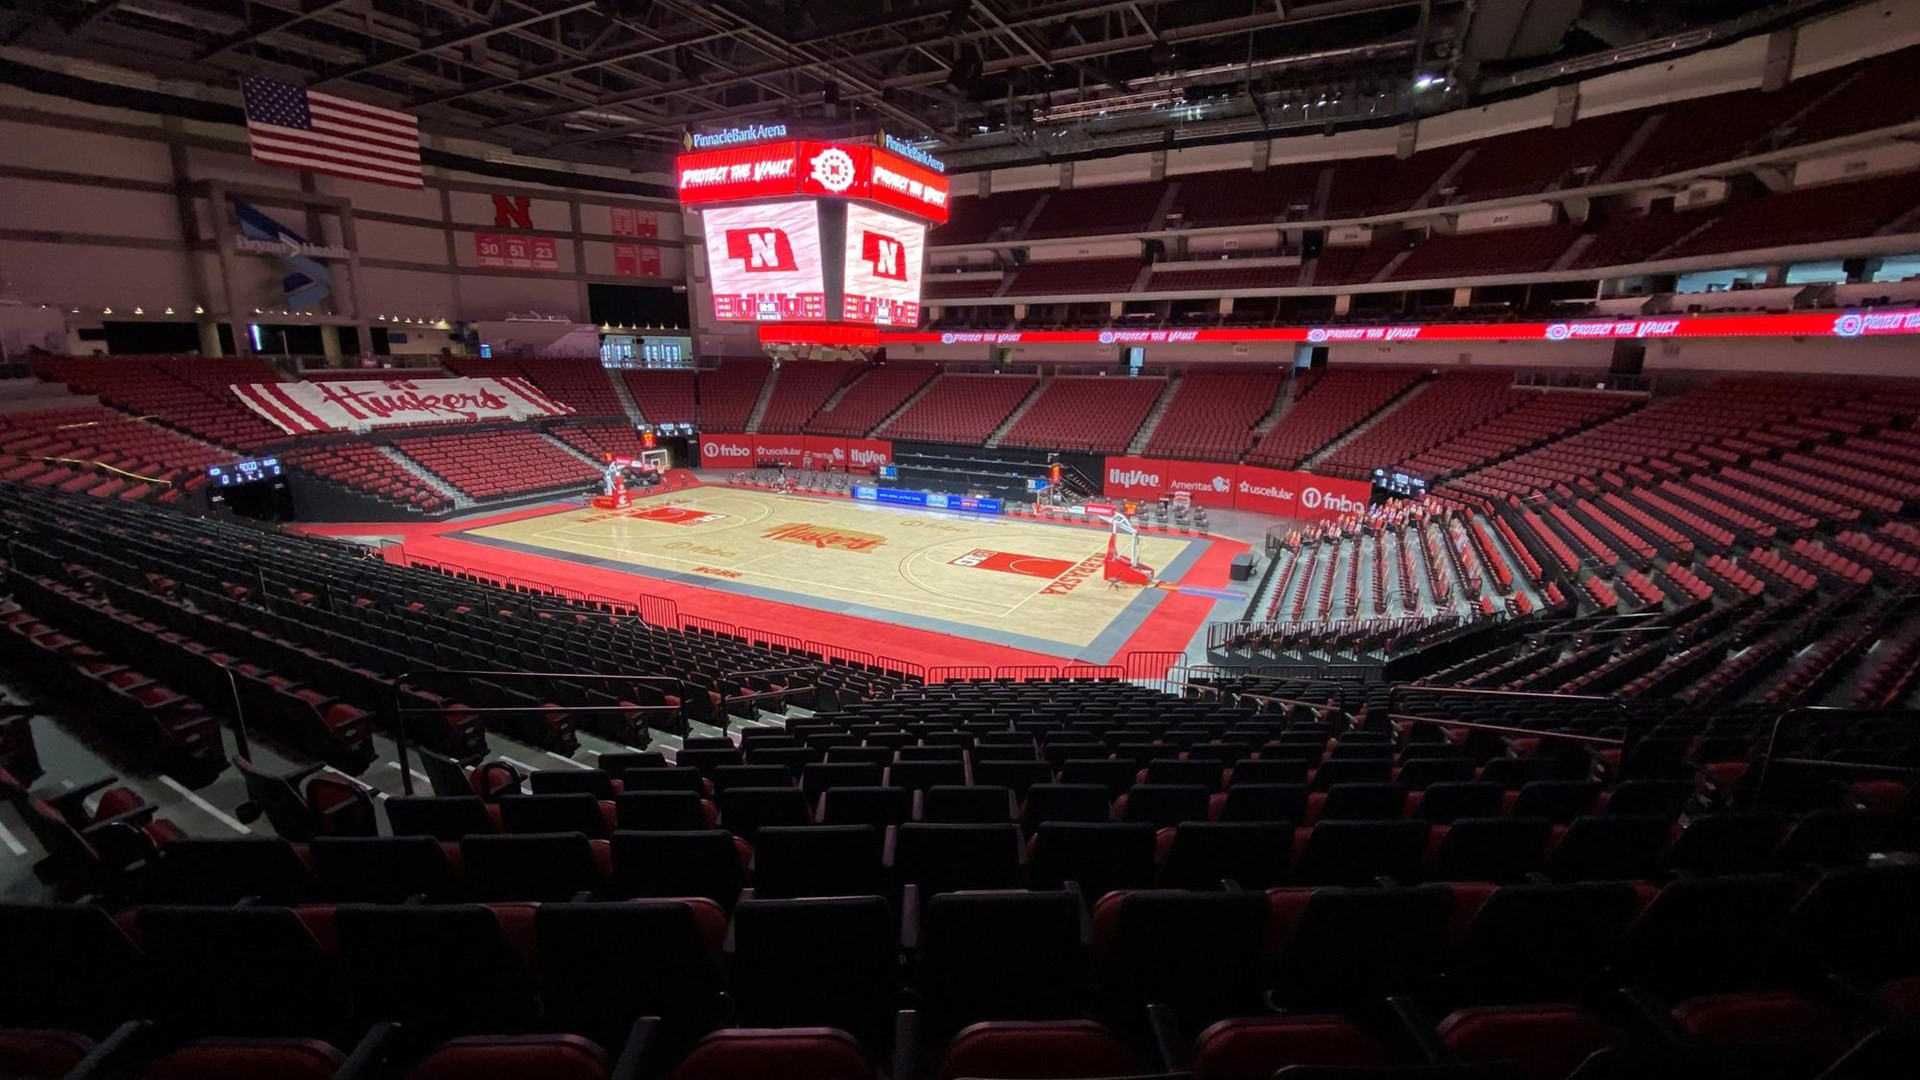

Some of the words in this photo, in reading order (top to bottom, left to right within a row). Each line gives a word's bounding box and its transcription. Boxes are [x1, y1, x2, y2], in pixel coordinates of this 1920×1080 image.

[757, 124, 787, 138] Arena
[928, 153, 945, 172] Arena
[681, 166, 730, 188] PROTECT
[729, 163, 752, 180] THE
[753, 158, 795, 182] VAULT
[492, 194, 533, 229] N
[480, 243, 499, 255] 30
[510, 245, 526, 257] 51
[535, 247, 553, 259] 23
[748, 232, 778, 268] N
[878, 239, 898, 275] N
[1567, 324, 1612, 339] PROTECT
[1614, 323, 1635, 335] THE
[1637, 320, 1680, 338] VAULT
[1860, 314, 1904, 334] PROTECT
[954, 334, 982, 343] PROTECT
[997, 333, 1022, 343] VAULT
[1112, 332, 1150, 344] PROTECT
[1151, 332, 1167, 341] THE
[1168, 331, 1199, 343] VAULT
[1325, 328, 1365, 340] PROTECT
[1366, 328, 1384, 338] THE
[1385, 327, 1421, 340] VAULT
[323, 386, 508, 420] Huskers
[720, 444, 750, 457] fnbo
[765, 447, 801, 456] uscellular
[851, 449, 887, 465] HyVee
[1109, 468, 1160, 488] HyVee
[1170, 479, 1213, 492] Ameritas
[1249, 484, 1294, 501] uscellular
[1323, 491, 1365, 515] fnbo
[760, 523, 888, 549] Huskers
[1039, 552, 1107, 595] NEBRASKA
